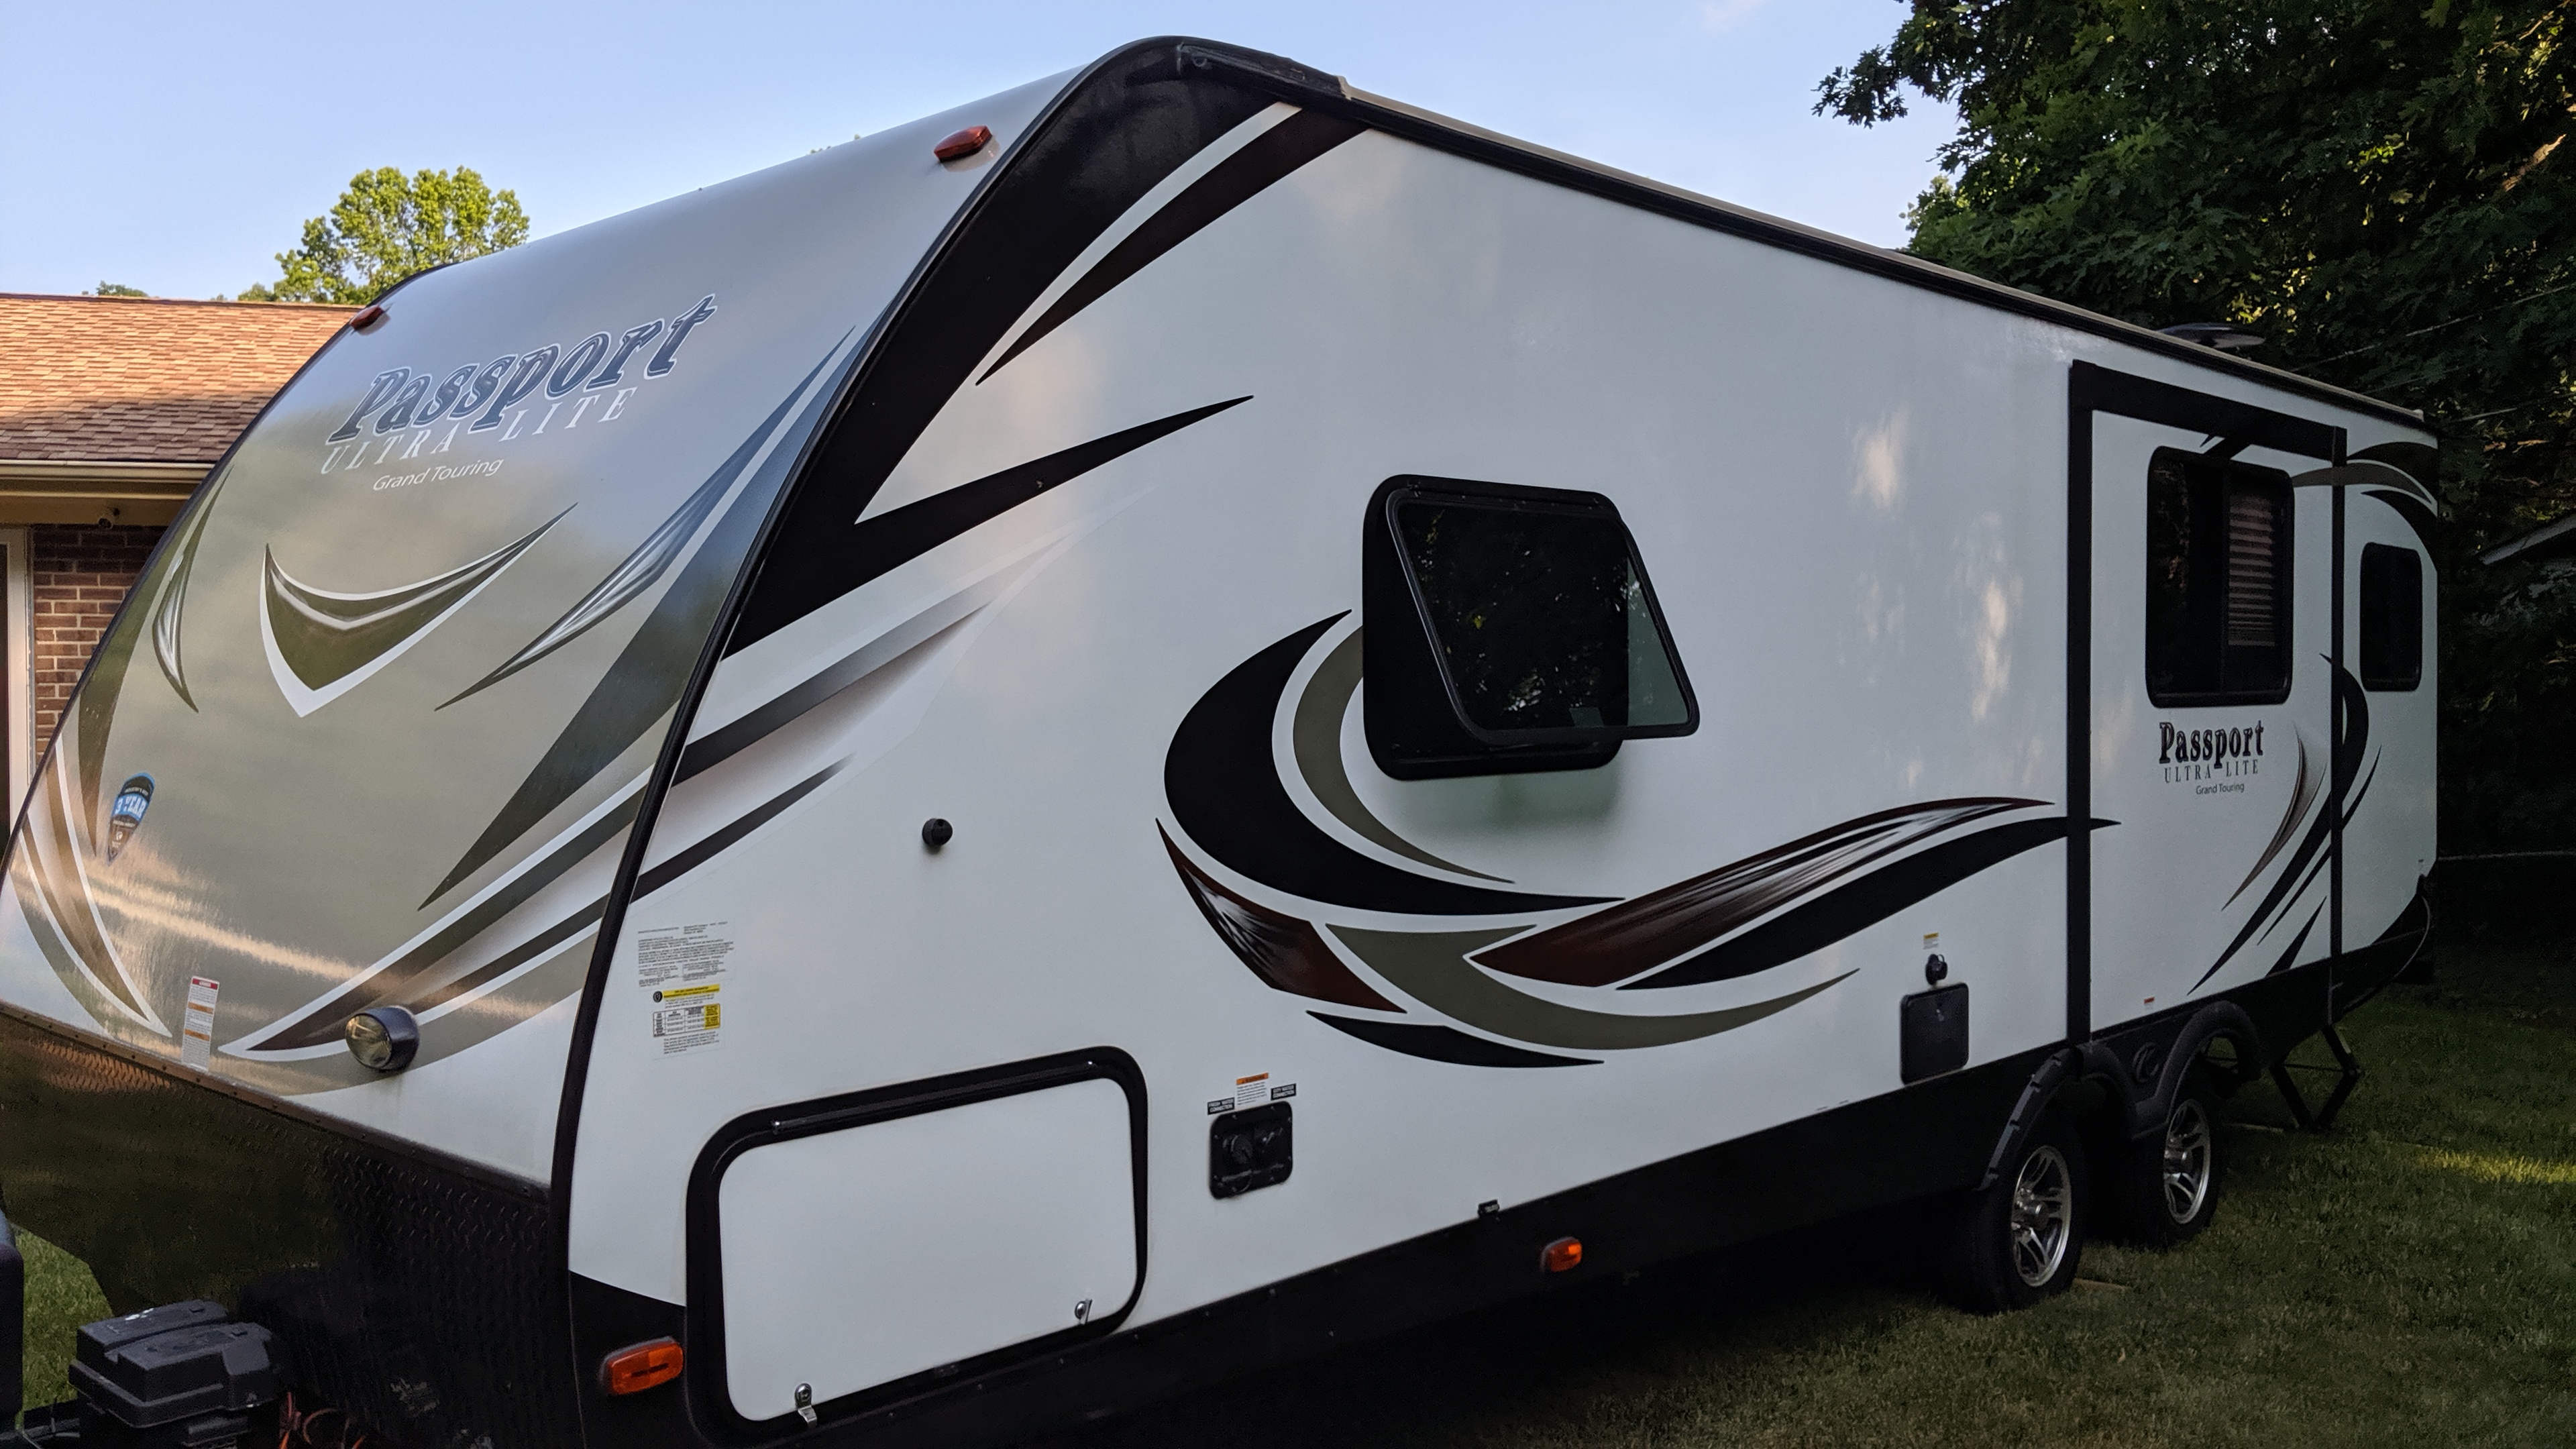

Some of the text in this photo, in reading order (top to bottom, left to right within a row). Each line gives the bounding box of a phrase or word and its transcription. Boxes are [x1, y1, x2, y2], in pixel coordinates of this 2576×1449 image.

[325, 293, 718, 445] Passport
[321, 386, 638, 474] ULTRA LITE
[373, 459, 504, 491] Grand Touring
[2159, 720, 2264, 769] Passport
[2165, 759, 2259, 784] ULTRA LITE
[2196, 783, 2245, 795] Grand Touring
